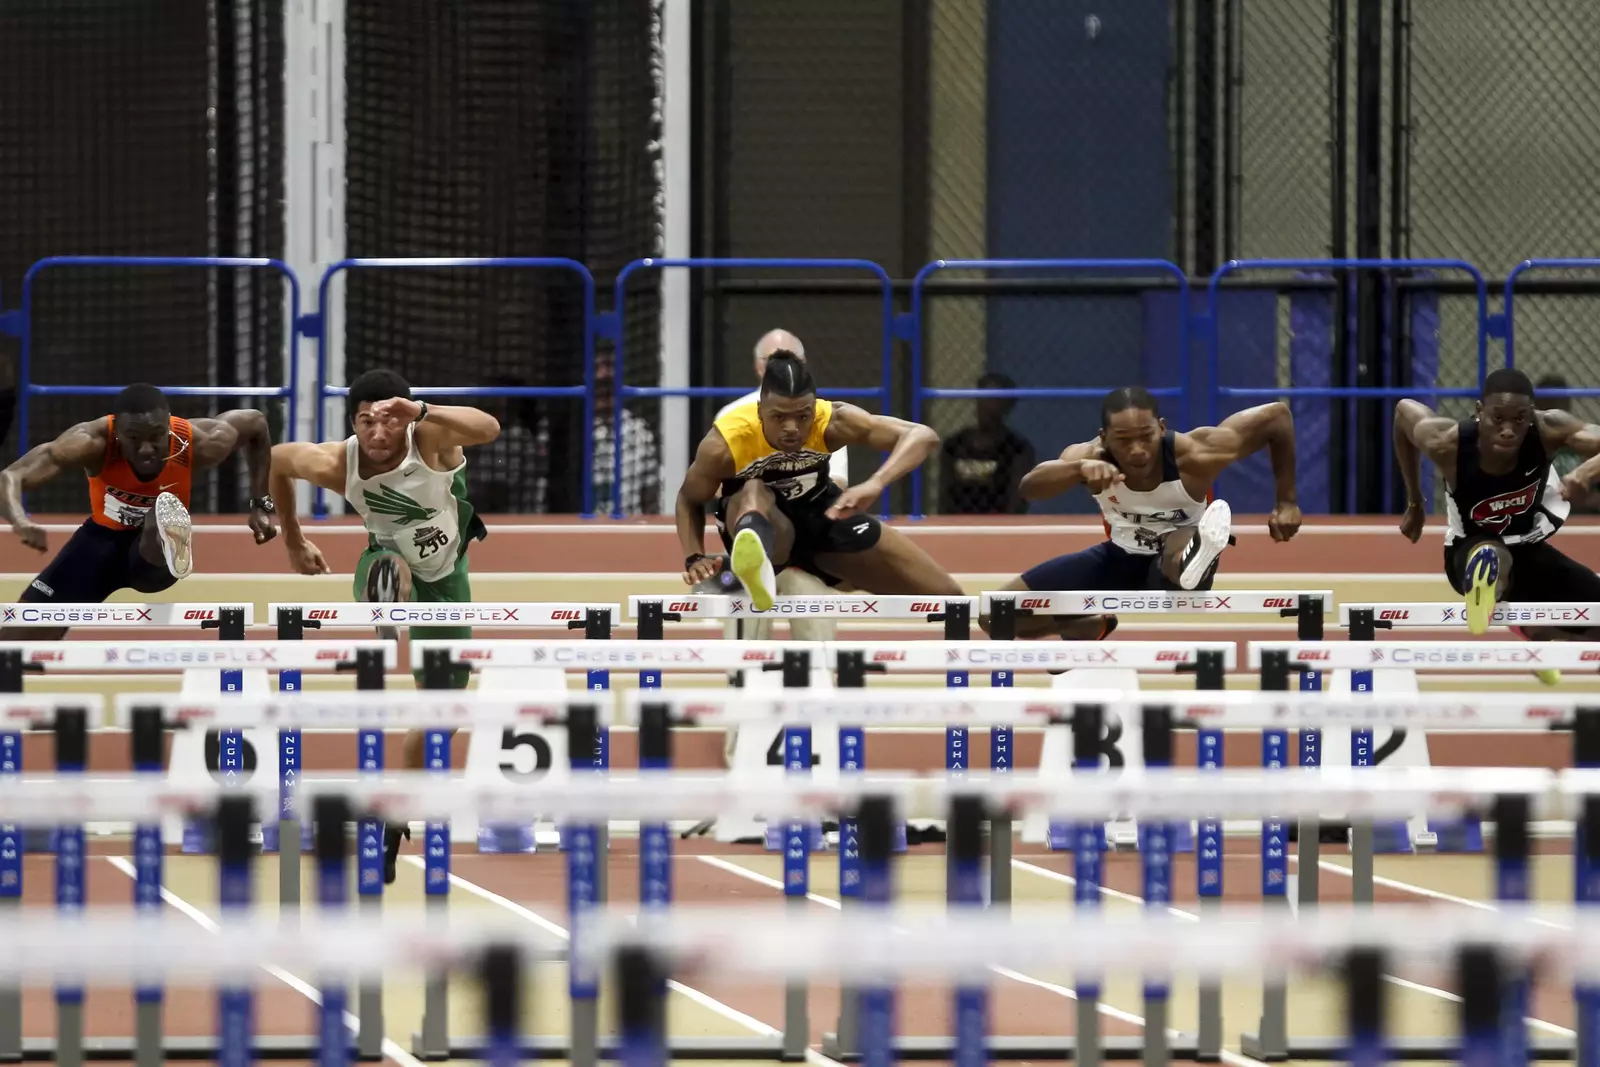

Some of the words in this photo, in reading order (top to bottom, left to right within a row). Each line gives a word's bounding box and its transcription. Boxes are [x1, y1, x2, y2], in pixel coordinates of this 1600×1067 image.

[105, 485, 157, 505] UTE
[1489, 495, 1527, 512] WKU
[668, 602, 698, 612] GILL
[910, 602, 940, 612] GILL
[1020, 599, 1050, 608] GILL
[1102, 596, 1231, 609] CROSSPLEX
[1263, 598, 1293, 608] GILL
[22, 608, 152, 621] CROSSPLEX
[184, 610, 214, 620] GILL
[308, 610, 338, 620] GILL
[390, 608, 519, 621] CROSSPLEX
[551, 610, 580, 620] GILL
[1379, 610, 1410, 619] GILL
[1461, 608, 1590, 620] OSSPLEX
[498, 727, 552, 785] 5
